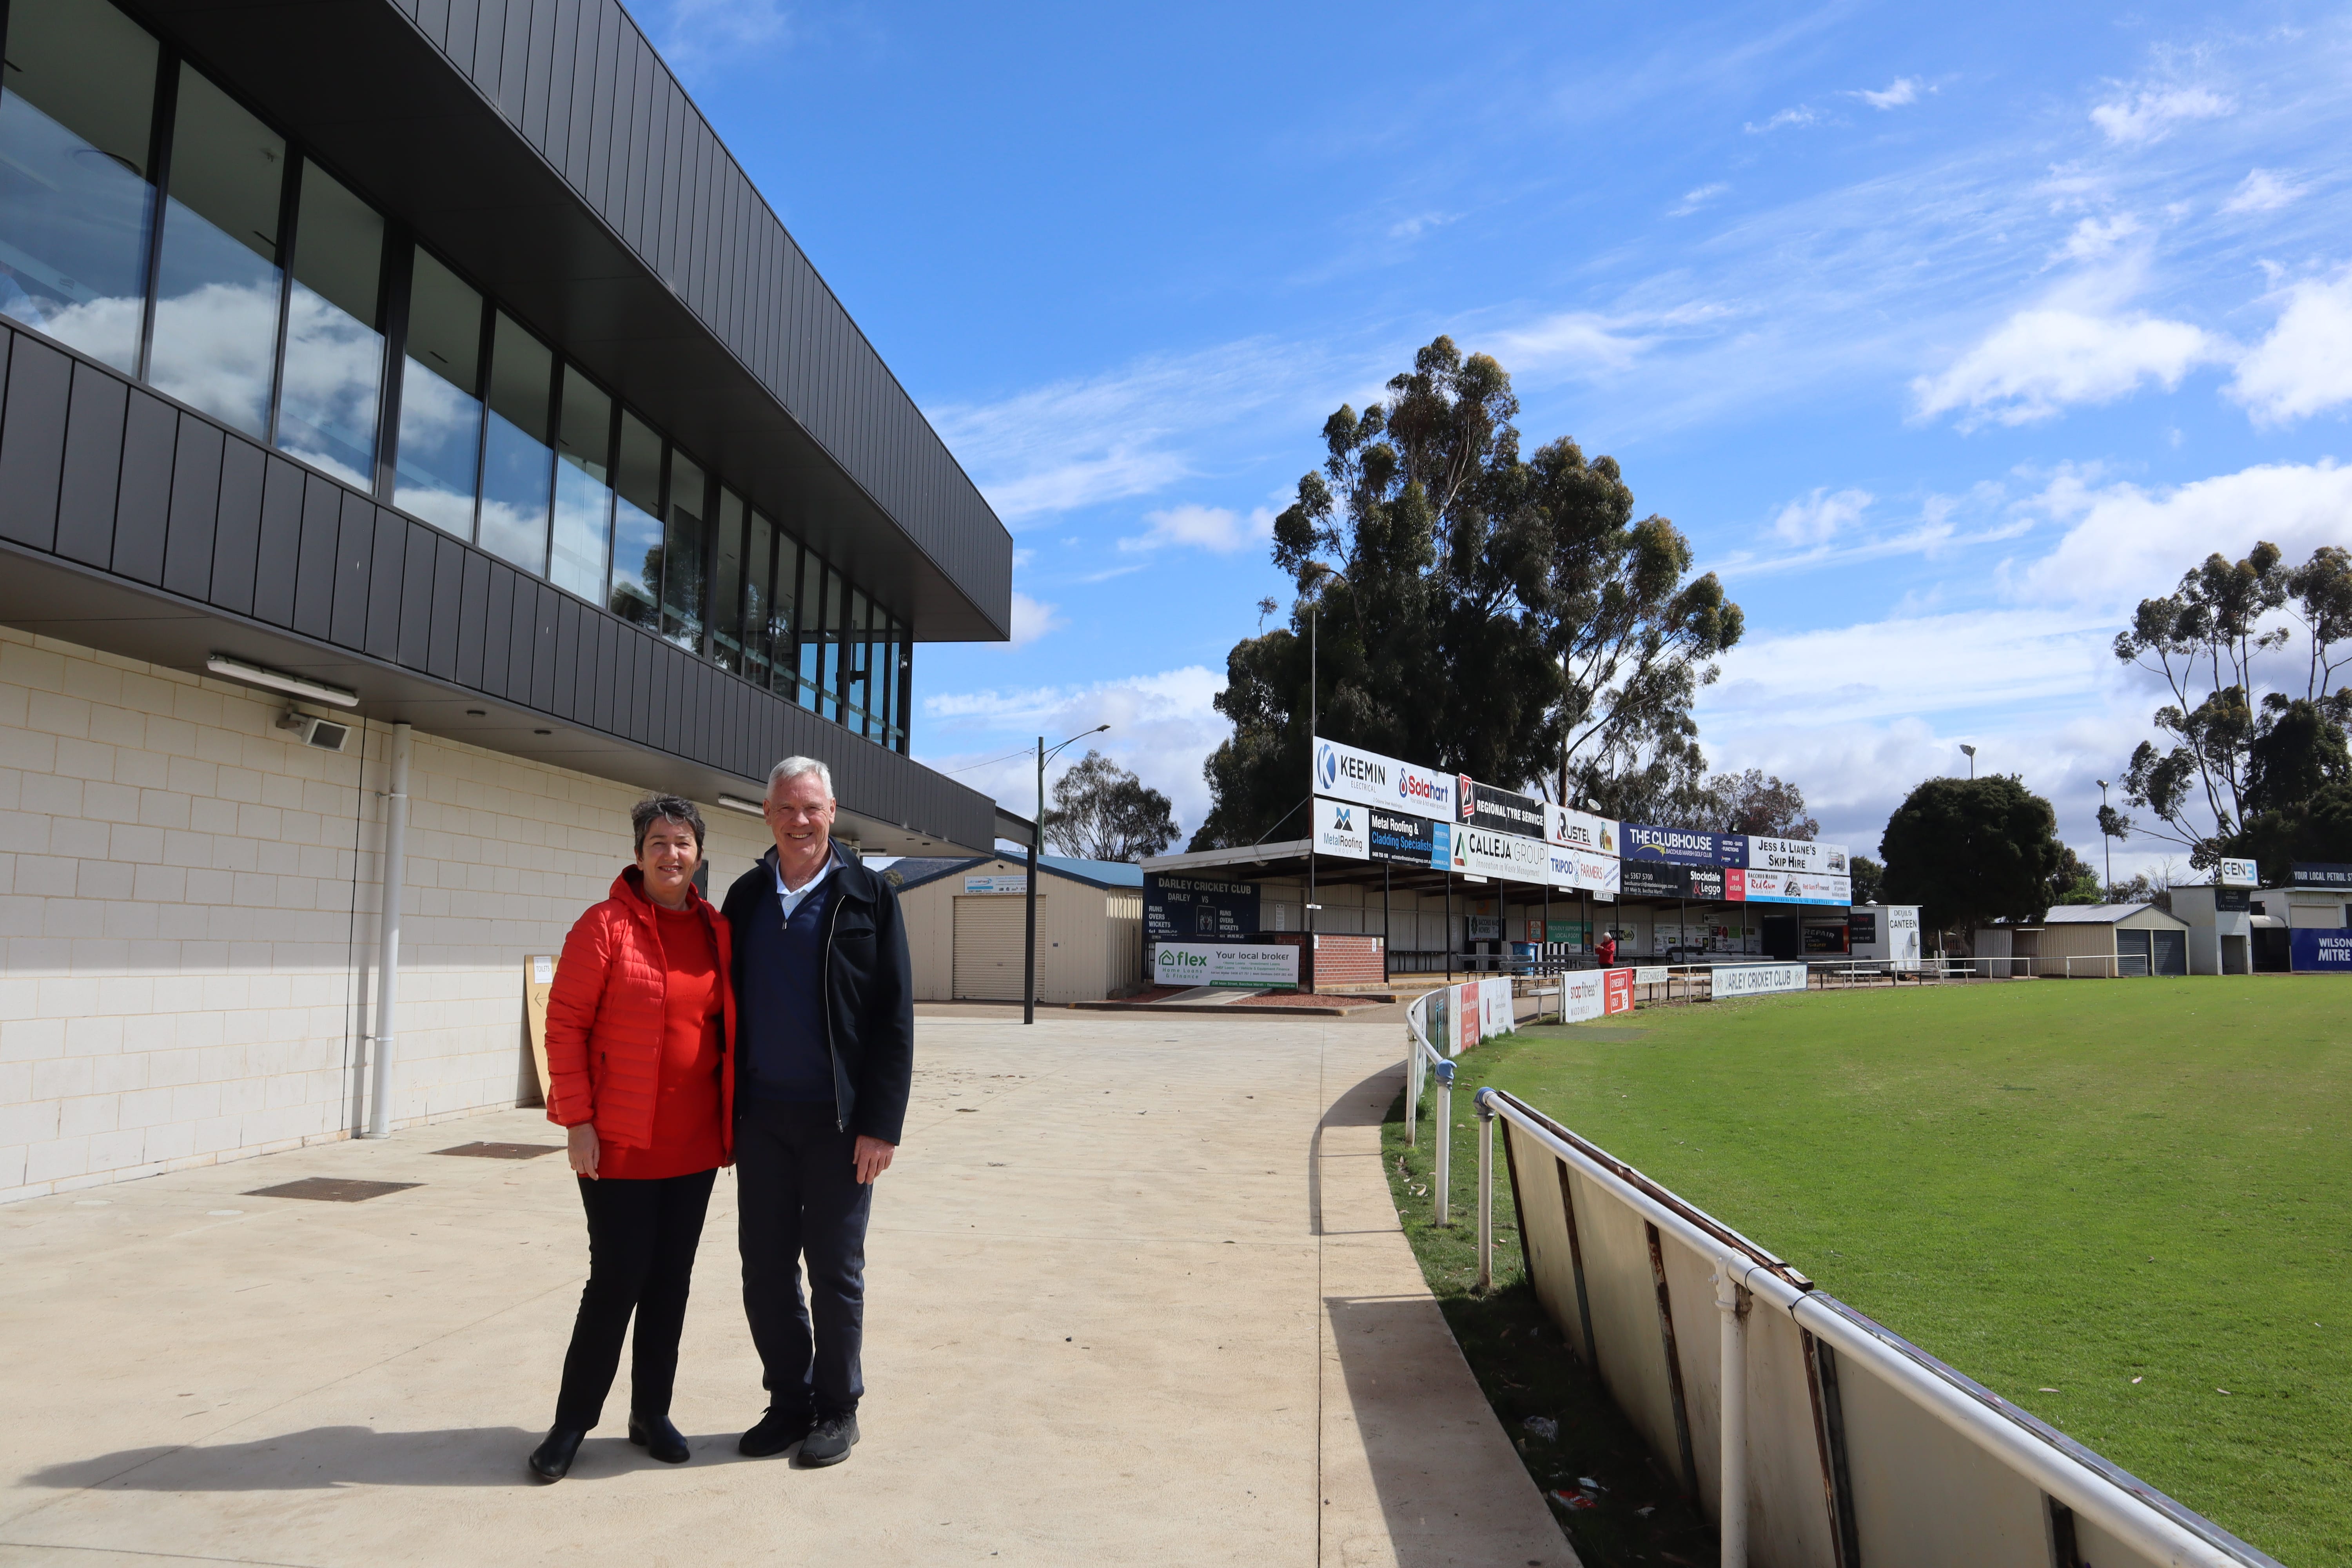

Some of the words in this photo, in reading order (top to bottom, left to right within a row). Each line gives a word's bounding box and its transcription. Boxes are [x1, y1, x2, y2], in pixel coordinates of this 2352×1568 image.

[1341, 755, 1385, 786] KEEMIN
[1351, 780, 1376, 793] ELECTRICAL
[1408, 775, 1448, 803] Solahart
[1477, 799, 1506, 817] REGIONAL
[1507, 807, 1521, 821] TYRE
[1522, 810, 1544, 826] SERVICE
[1372, 815, 1388, 830] Metal
[1390, 818, 1413, 837] Roofing
[1414, 822, 1419, 835] &
[1557, 812, 1590, 843] RUSTEL
[1324, 833, 1362, 852] MetalRoofing
[1372, 831, 1399, 849] Cladding
[1401, 836, 1432, 851] Specialists
[1630, 828, 1650, 844] THE
[1651, 831, 1712, 851] CLUBHOUSE
[1469, 833, 1512, 860] CALLEJA
[1514, 842, 1545, 865] GROUP
[1759, 840, 1777, 852] JESS
[1780, 842, 1786, 853] &
[1789, 842, 1816, 855] LIANE'S
[1476, 858, 1498, 870] Innovation
[1499, 862, 1503, 871] in
[1504, 863, 1516, 873] Waste
[1517, 866, 1539, 878] Management
[1769, 854, 1786, 867] SKIP
[1788, 856, 1806, 868] HIRE
[1551, 858, 1573, 875] TRIPOD
[1581, 864, 1602, 880] FARMERS
[1690, 870, 1721, 882] Stockdale
[2223, 862, 2256, 881] GEN3
[2294, 871, 2308, 880] YOUR
[2309, 871, 2325, 881] LOCAL
[2327, 871, 2346, 881] PETROL
[1158, 877, 1192, 889] DARLEY
[1194, 881, 1229, 893] CRICKET
[1231, 884, 1251, 894] CLUB
[1693, 881, 1702, 896] &
[1701, 882, 1721, 895] Leggo
[1751, 878, 1762, 889] Red
[1763, 880, 1775, 889] Gum
[1815, 882, 1829, 891] Firewood
[1168, 893, 1191, 902] DARLEY
[1890, 920, 1917, 928] CANTEEN
[1804, 929, 1835, 938] REPAIR
[2318, 938, 2352, 947] WILSON
[1177, 951, 1207, 967] flex
[2318, 949, 2350, 961] MITRE
[1611, 978, 1625, 988] EYNESBURY
[1639, 971, 1659, 981] INTERCHANGE
[1748, 971, 1773, 989] CRICKET
[1774, 970, 1791, 987] CLUB
[1571, 986, 1581, 1004] snap
[1582, 981, 1595, 998] fitness
[1571, 1005, 1590, 1016] MADDINGLEY
